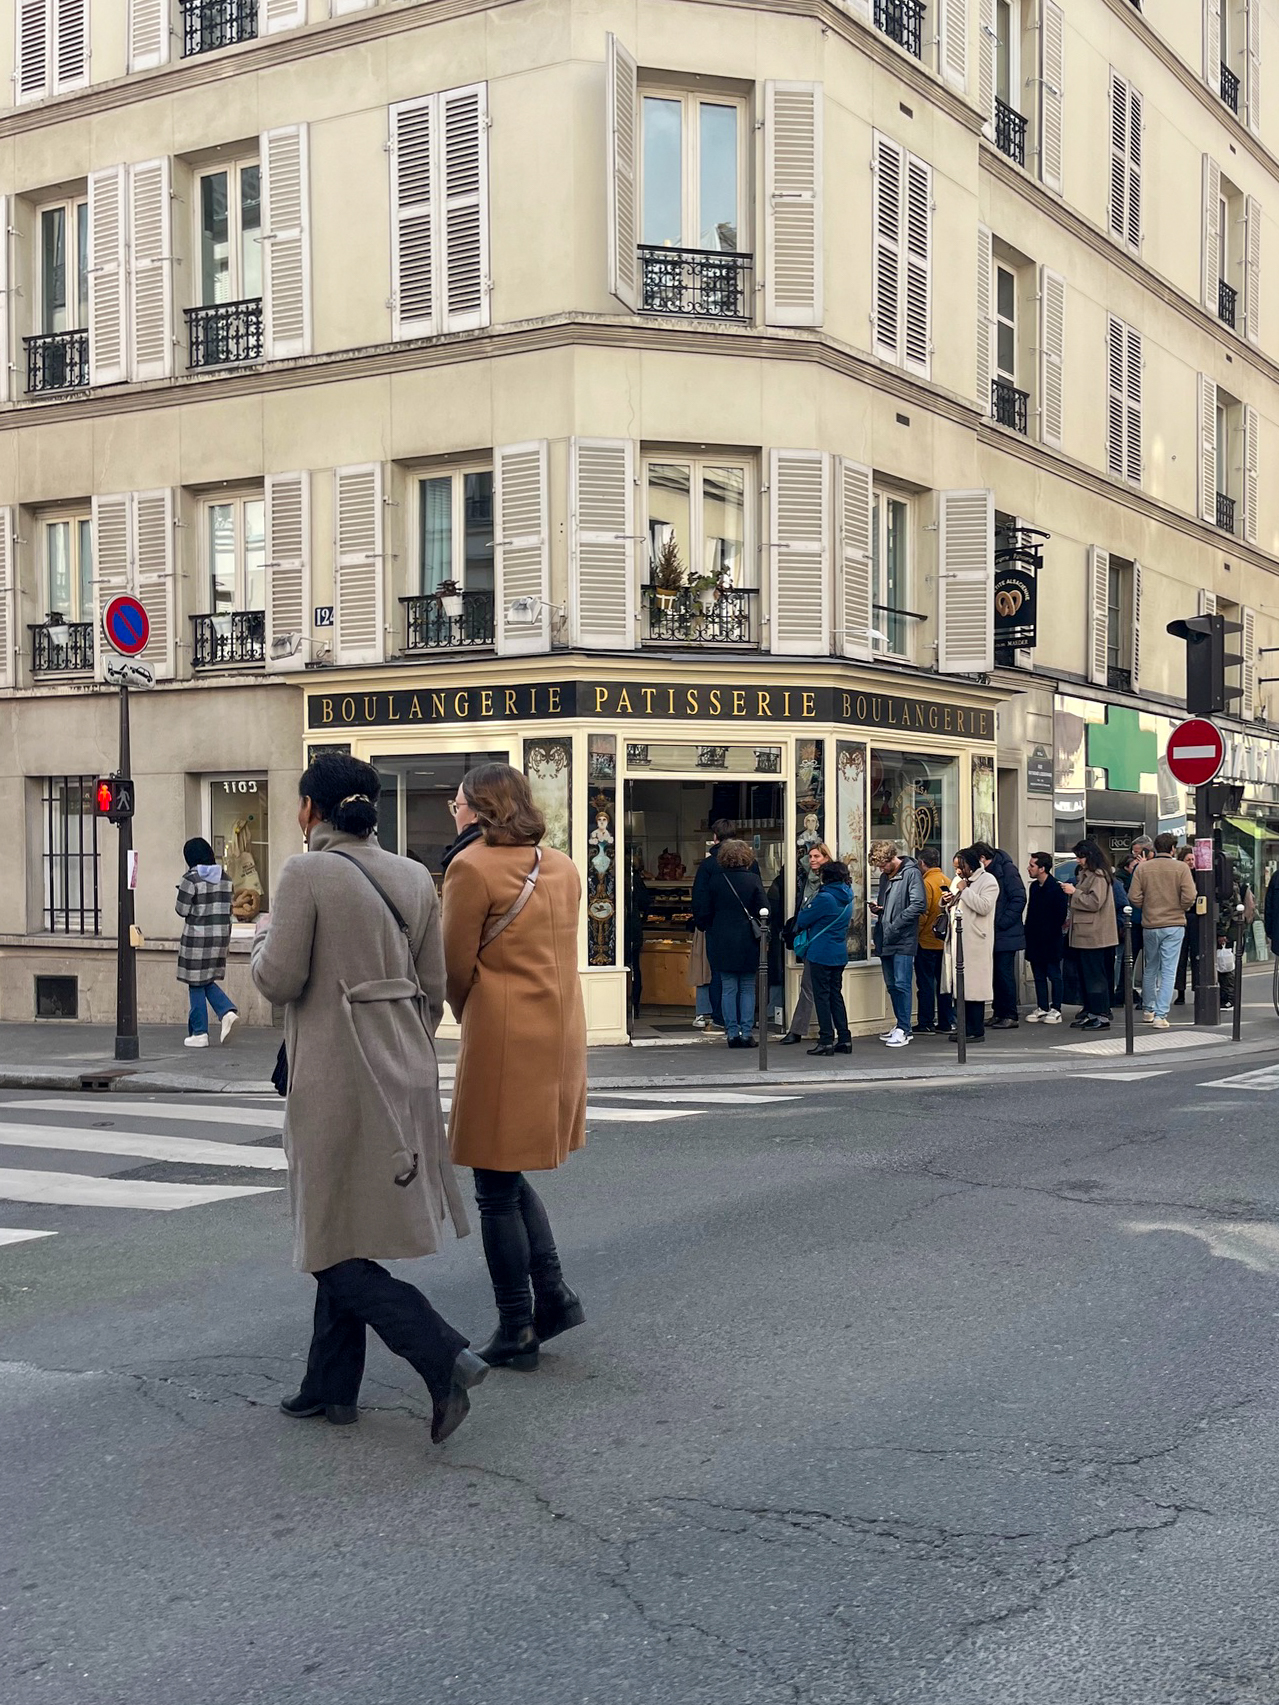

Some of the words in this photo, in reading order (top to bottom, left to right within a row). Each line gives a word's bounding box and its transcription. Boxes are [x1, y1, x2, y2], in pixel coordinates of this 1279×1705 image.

[1006, 579, 1030, 601] ALSACIENNE
[321, 687, 562, 723] BOULANGERIE
[594, 687, 816, 717] PATISSERIE
[842, 693, 988, 735] BOULANGERIE
